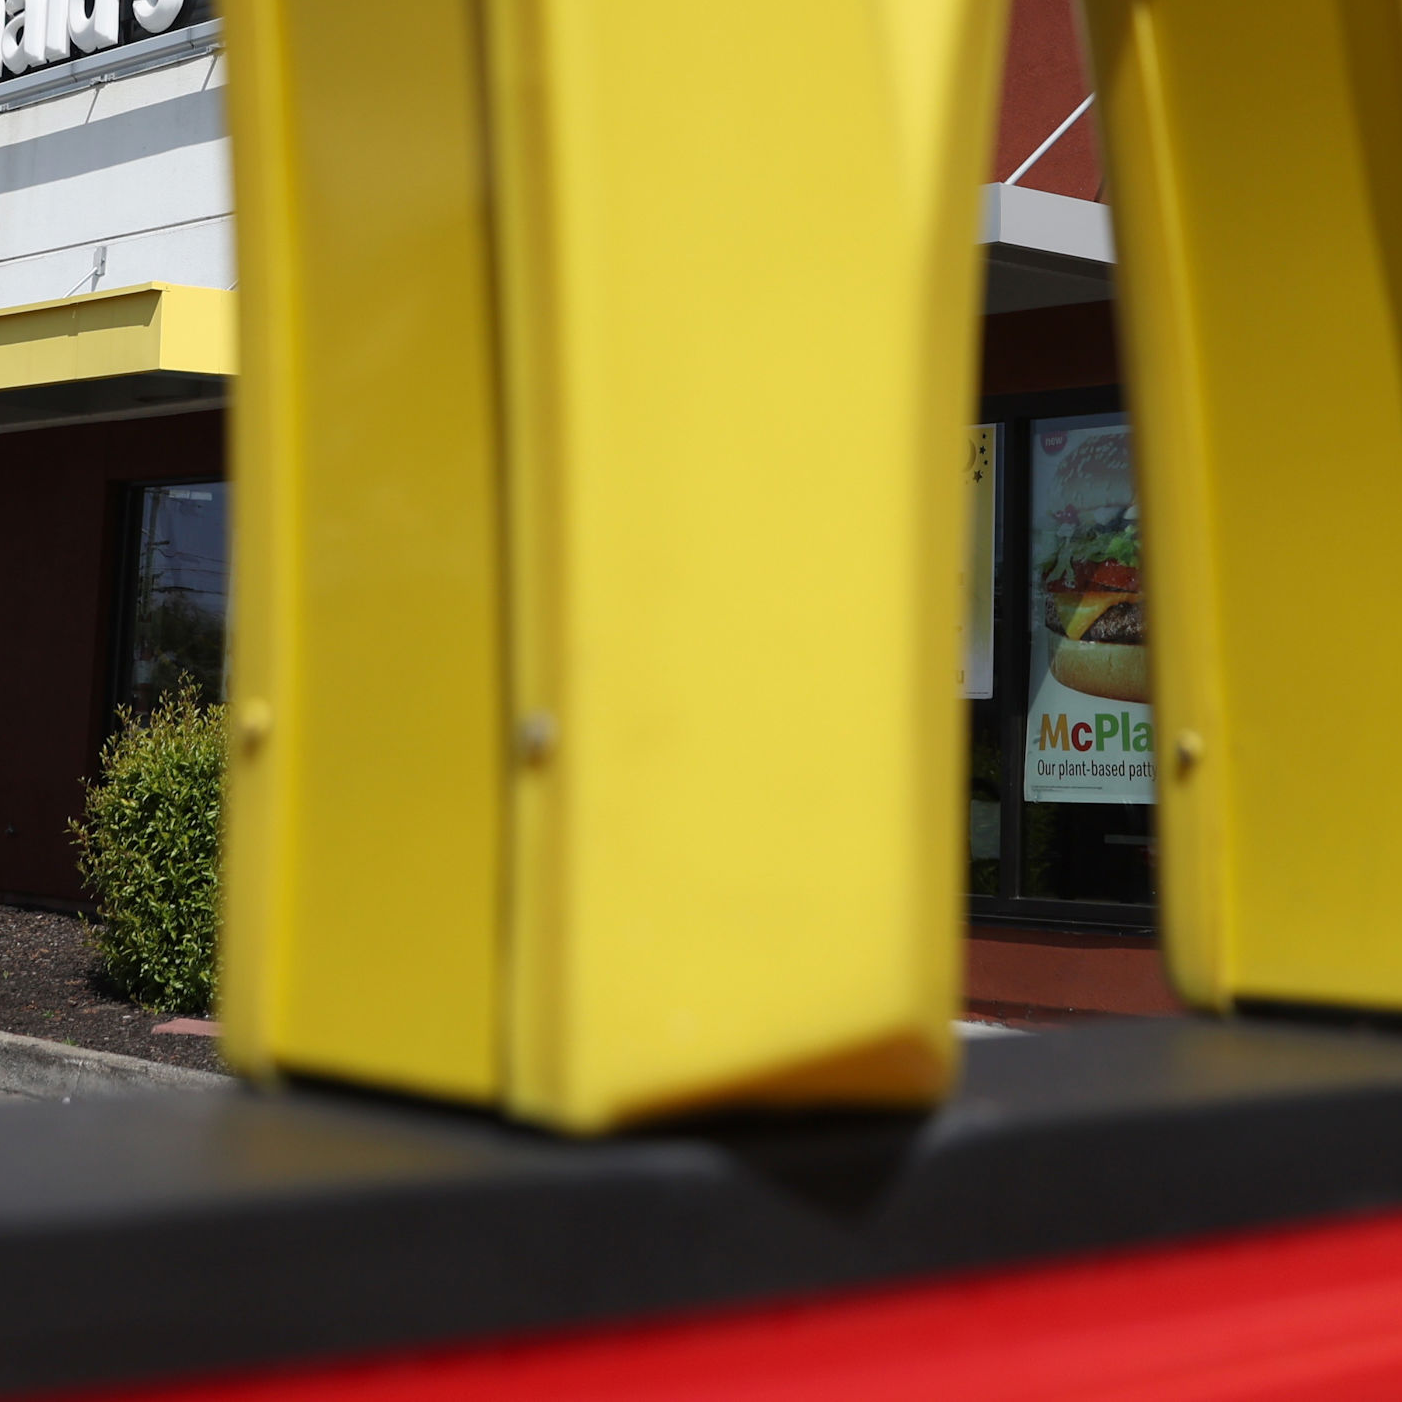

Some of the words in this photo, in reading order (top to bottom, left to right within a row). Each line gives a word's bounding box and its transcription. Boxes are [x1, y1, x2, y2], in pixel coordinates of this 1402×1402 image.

[1038, 711, 1155, 753] McPla
[1038, 759, 1055, 776] Our
[1059, 759, 1126, 780] plant-based
